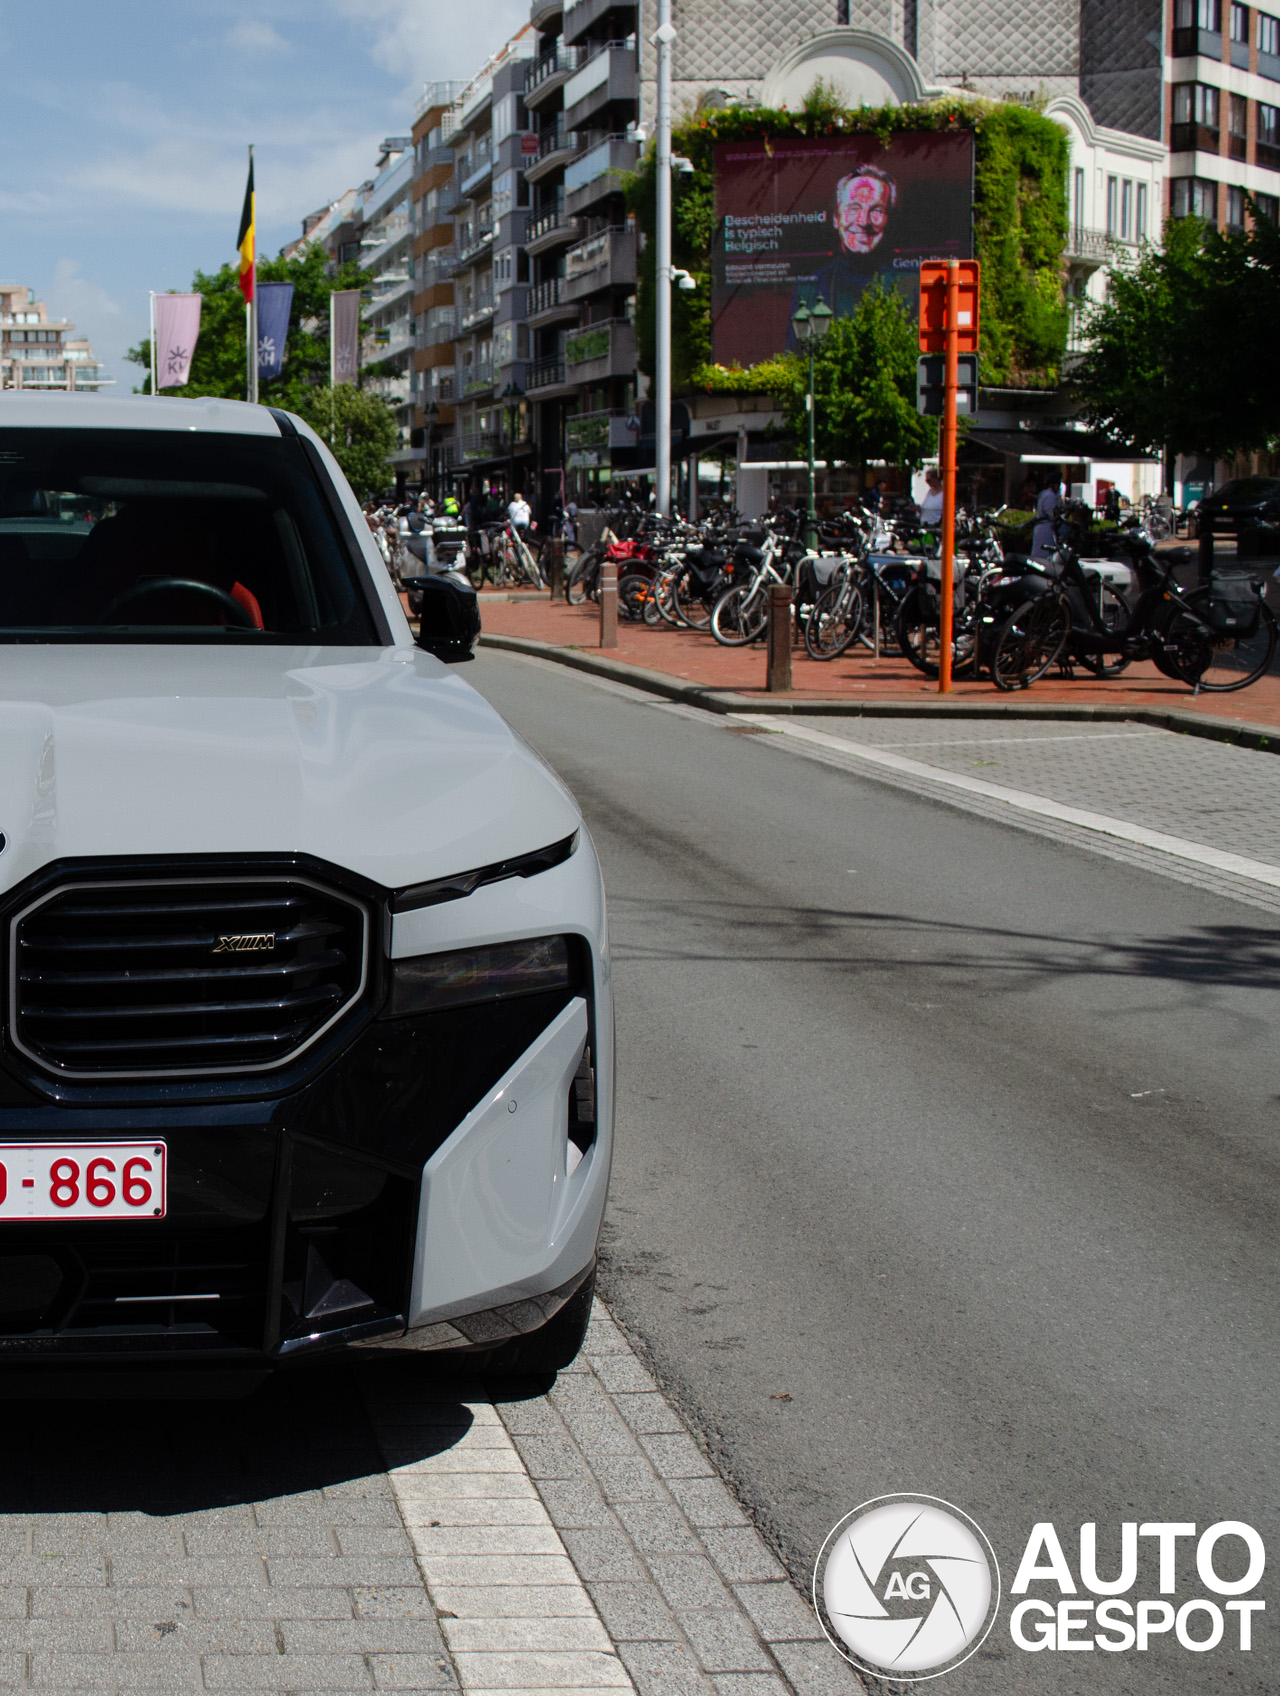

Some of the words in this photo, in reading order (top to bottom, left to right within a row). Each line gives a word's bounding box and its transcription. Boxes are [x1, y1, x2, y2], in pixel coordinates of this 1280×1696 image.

[724, 210, 827, 227] Bescheidenheid
[737, 226, 783, 240] typisch
[724, 240, 779, 253] Belgisch
